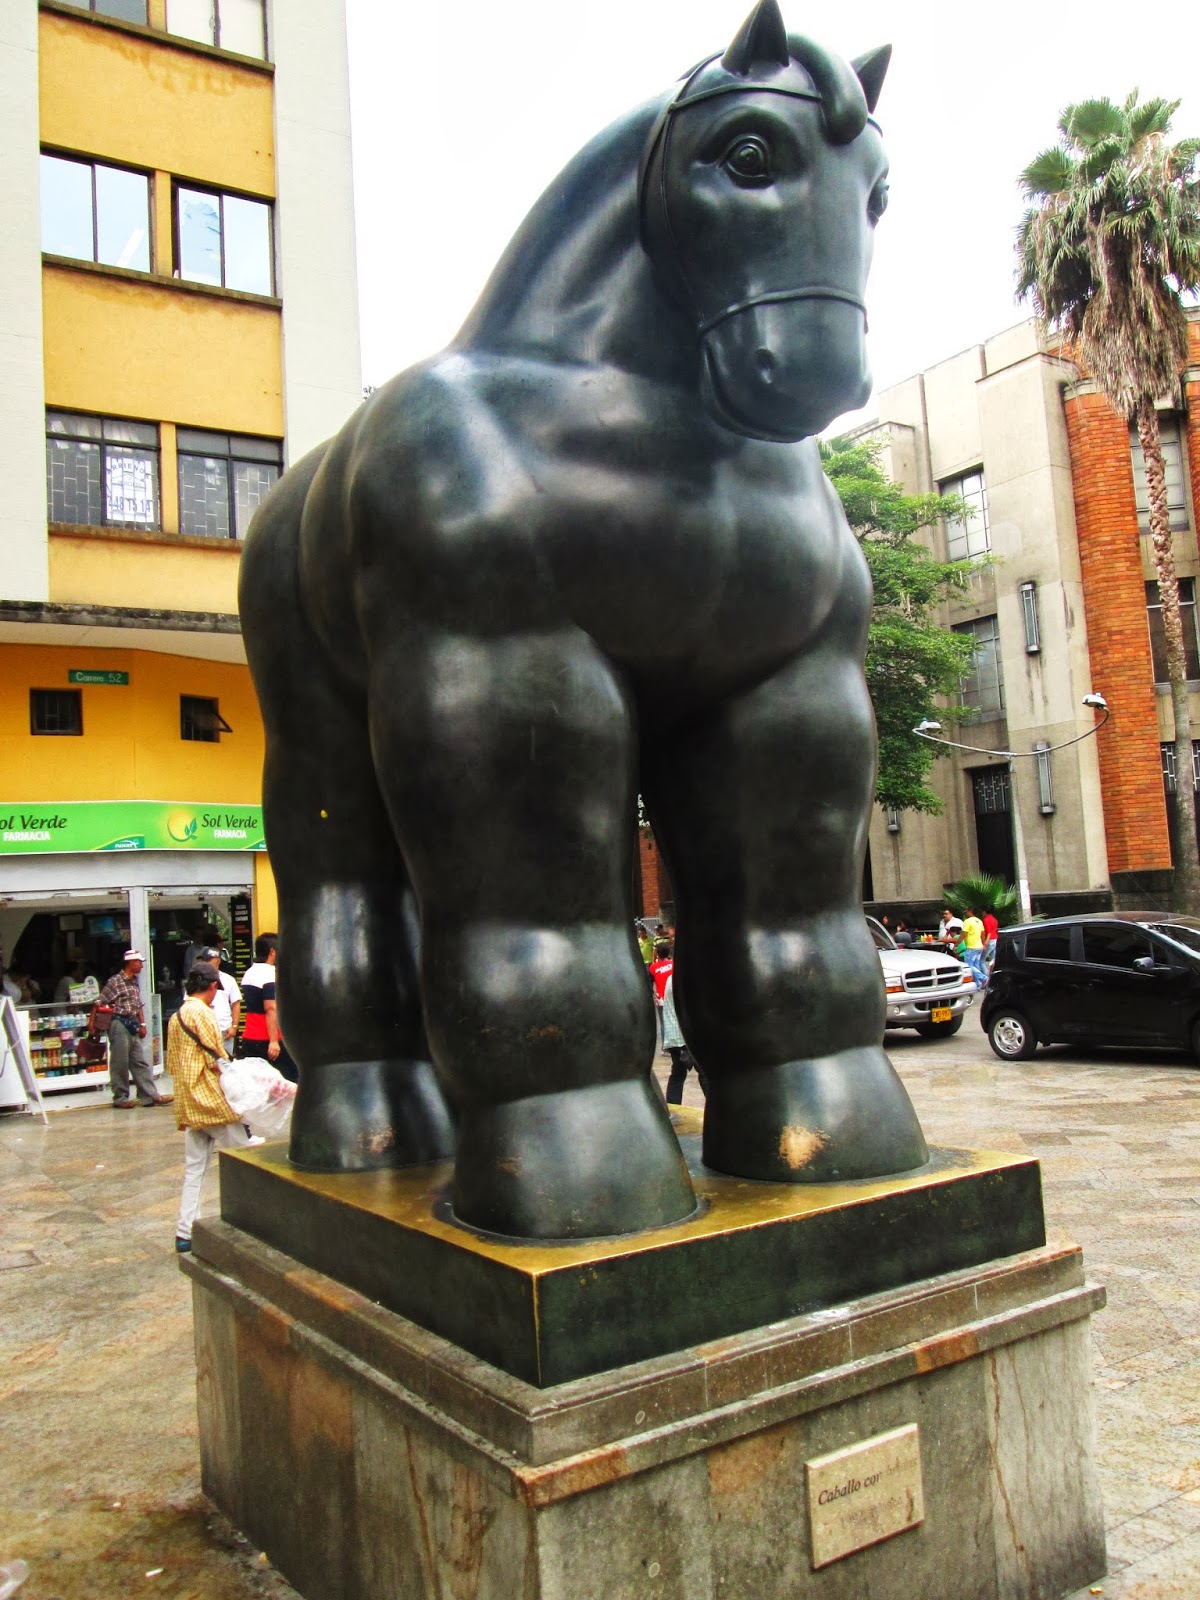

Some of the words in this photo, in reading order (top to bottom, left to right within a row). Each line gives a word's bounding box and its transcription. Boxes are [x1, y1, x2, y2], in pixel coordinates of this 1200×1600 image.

[108, 673, 122, 683] 52
[0, 815, 15, 830] ol
[20, 814, 68, 830] Verde
[201, 813, 221, 828] Sol
[224, 814, 258, 829] Verde
[3, 831, 51, 841] FARMACIA
[213, 829, 247, 839] FARMACIA
[818, 1478, 861, 1506] Caballo
